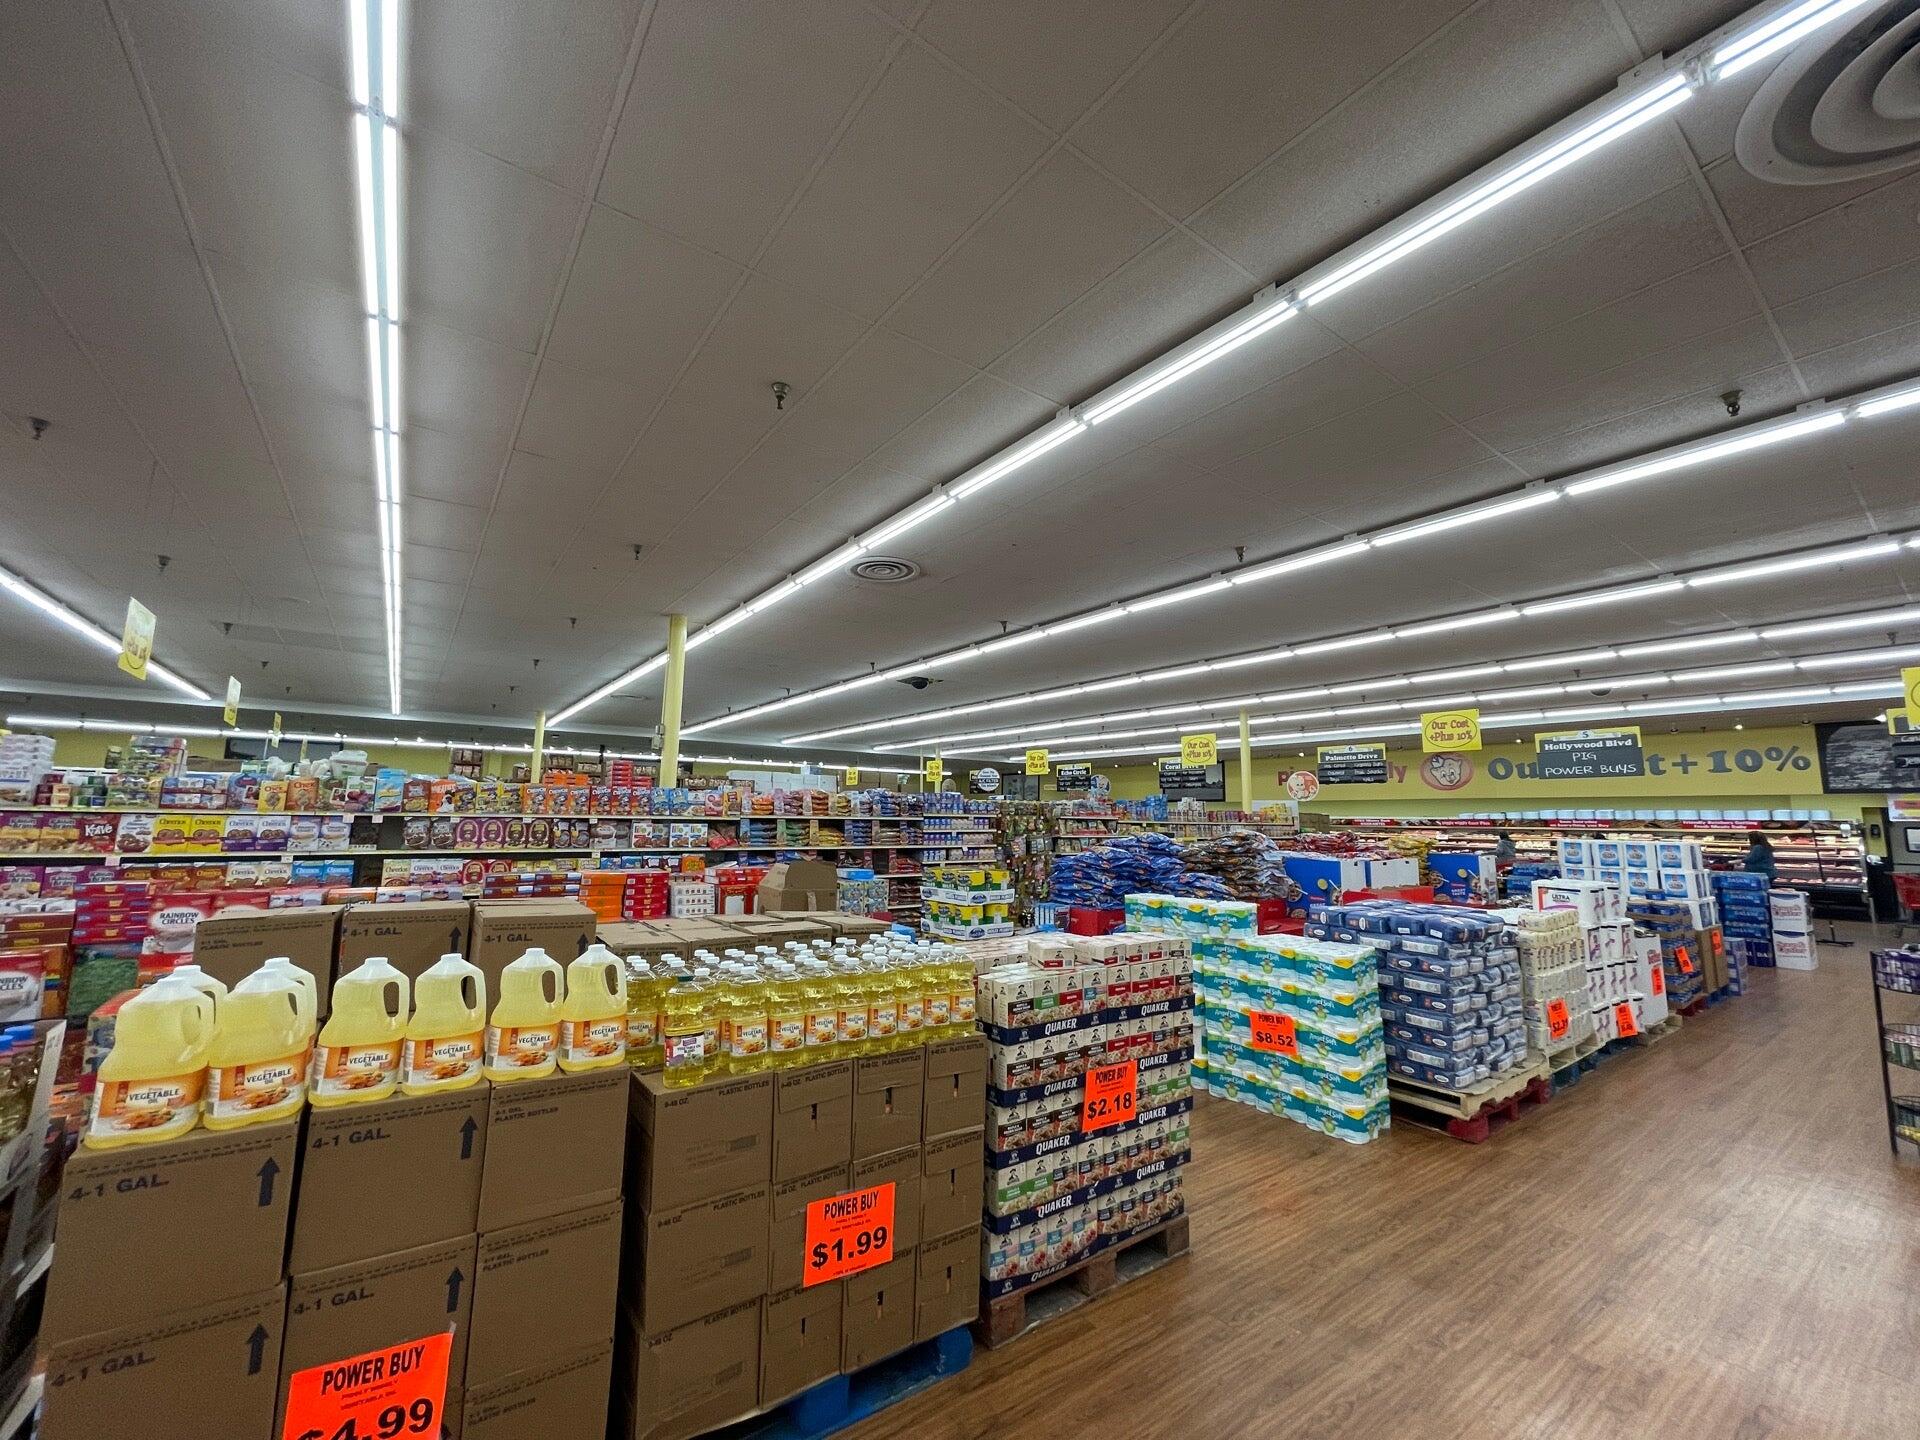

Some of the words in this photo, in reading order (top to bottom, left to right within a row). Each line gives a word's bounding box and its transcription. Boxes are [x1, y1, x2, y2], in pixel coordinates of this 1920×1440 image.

[1432, 721, 1447, 730] Our
[1451, 719, 1470, 729] Cost
[1457, 730, 1473, 741] 10%
[1199, 741, 1210, 749] Cost
[1545, 740, 1603, 751] Hollywood
[1606, 739, 1633, 747] Blvd
[1572, 752, 1597, 762] PIG
[1487, 757, 1537, 780] Ou
[1545, 766, 1594, 777] POWER
[1600, 764, 1637, 774] BUYS
[159, 911, 199, 920] RAINBOW
[161, 917, 195, 925] CIRCLES
[351, 928, 370, 937] 4-1
[0, 976, 28, 984] NBOW
[1141, 1002, 1169, 1016] QUAKER
[591, 1026, 620, 1036] VEGETABLE
[1045, 1018, 1078, 1036] QUAKER
[518, 1034, 551, 1045] VEGETABLE
[1256, 1030, 1294, 1048] $8.52
[349, 1053, 389, 1065] VEGETABLE
[434, 1044, 471, 1056] VEGETABLE
[882, 1058, 900, 1067] PLASTIC
[901, 1055, 921, 1064] BOTTLES
[1139, 1053, 1168, 1070] QUAKER
[246, 1068, 292, 1083] VEGETABLE
[805, 1073, 827, 1083] PLASTIC
[828, 1067, 850, 1078] BOTTLES
[1095, 1068, 1117, 1085] POWER
[1117, 1066, 1128, 1080] BUY
[129, 1088, 180, 1101] VEGETABLE
[718, 1085, 741, 1097] PLASTIC
[743, 1080, 770, 1092] BOTTLES
[1044, 1078, 1078, 1096] QUAKER
[495, 1112, 526, 1123] PLASTIC
[527, 1107, 558, 1119] BOTTLES
[1087, 1091, 1132, 1121] $2.18
[1139, 1106, 1167, 1125] QUAKER
[312, 1135, 340, 1149] 4-1
[349, 1127, 391, 1144] GAL.
[1036, 1135, 1071, 1155] QUAKER
[878, 1160, 897, 1170] PLASTIC
[898, 1152, 919, 1164] BOTTLES
[1137, 1161, 1165, 1179] QUAKER
[68, 1184, 104, 1201] 4-1
[116, 1174, 169, 1193] GAL.
[800, 1178, 821, 1189] PLASTIC
[821, 1168, 845, 1181] BOTTLES
[713, 1201, 738, 1212] PLASTIC
[739, 1190, 765, 1203] BOTTLES
[823, 1196, 858, 1221] POWER
[860, 1190, 879, 1212] BUY
[1037, 1195, 1073, 1217] QUAKER
[811, 1226, 888, 1270] $1.99
[482, 1258, 515, 1272] PLASTIC
[517, 1249, 549, 1262] BOTTLES
[1032, 1261, 1068, 1282] QUAKER
[294, 1299, 322, 1315] 4-1
[332, 1287, 375, 1307] GAL.
[703, 1311, 729, 1326] PLASTIC
[730, 1301, 759, 1317] BOTTLES
[51, 1366, 89, 1386] 4-1
[101, 1352, 156, 1374] GAL.
[321, 1356, 385, 1396] POWER
[388, 1344, 426, 1378] BUY
[297, 1397, 434, 1440] 4.99
